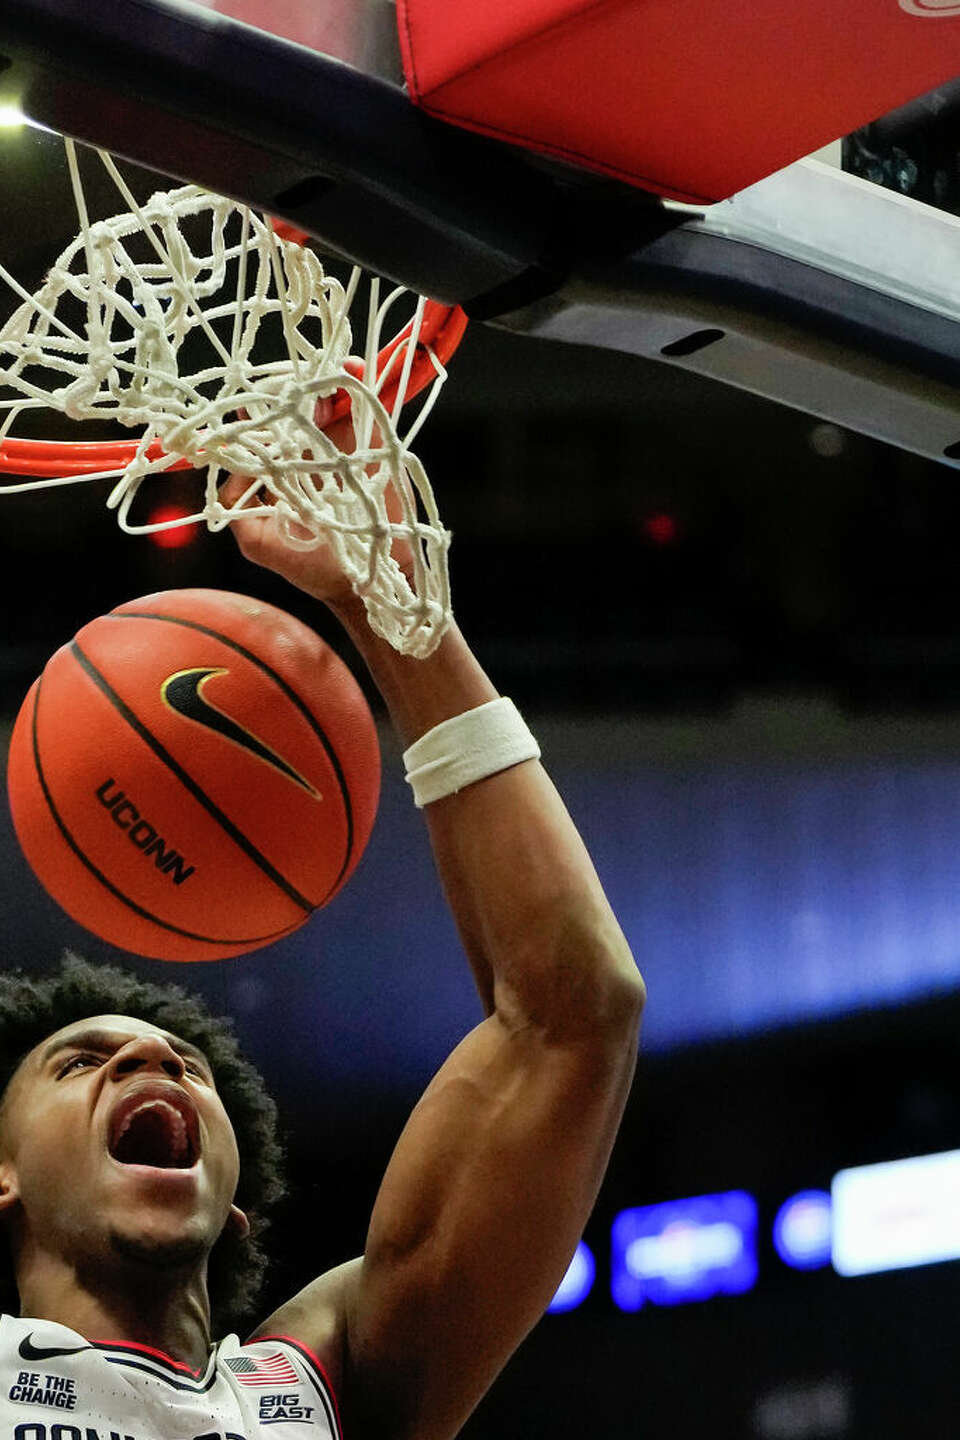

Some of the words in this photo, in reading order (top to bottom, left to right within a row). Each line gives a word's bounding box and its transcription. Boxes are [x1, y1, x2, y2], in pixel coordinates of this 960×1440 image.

[98, 779, 194, 884] UCONN
[17, 1371, 41, 1387] BE
[45, 1375, 76, 1392] THE
[9, 1384, 78, 1410] CHANGE
[259, 1394, 300, 1408] BIG
[259, 1407, 315, 1420] EAST
